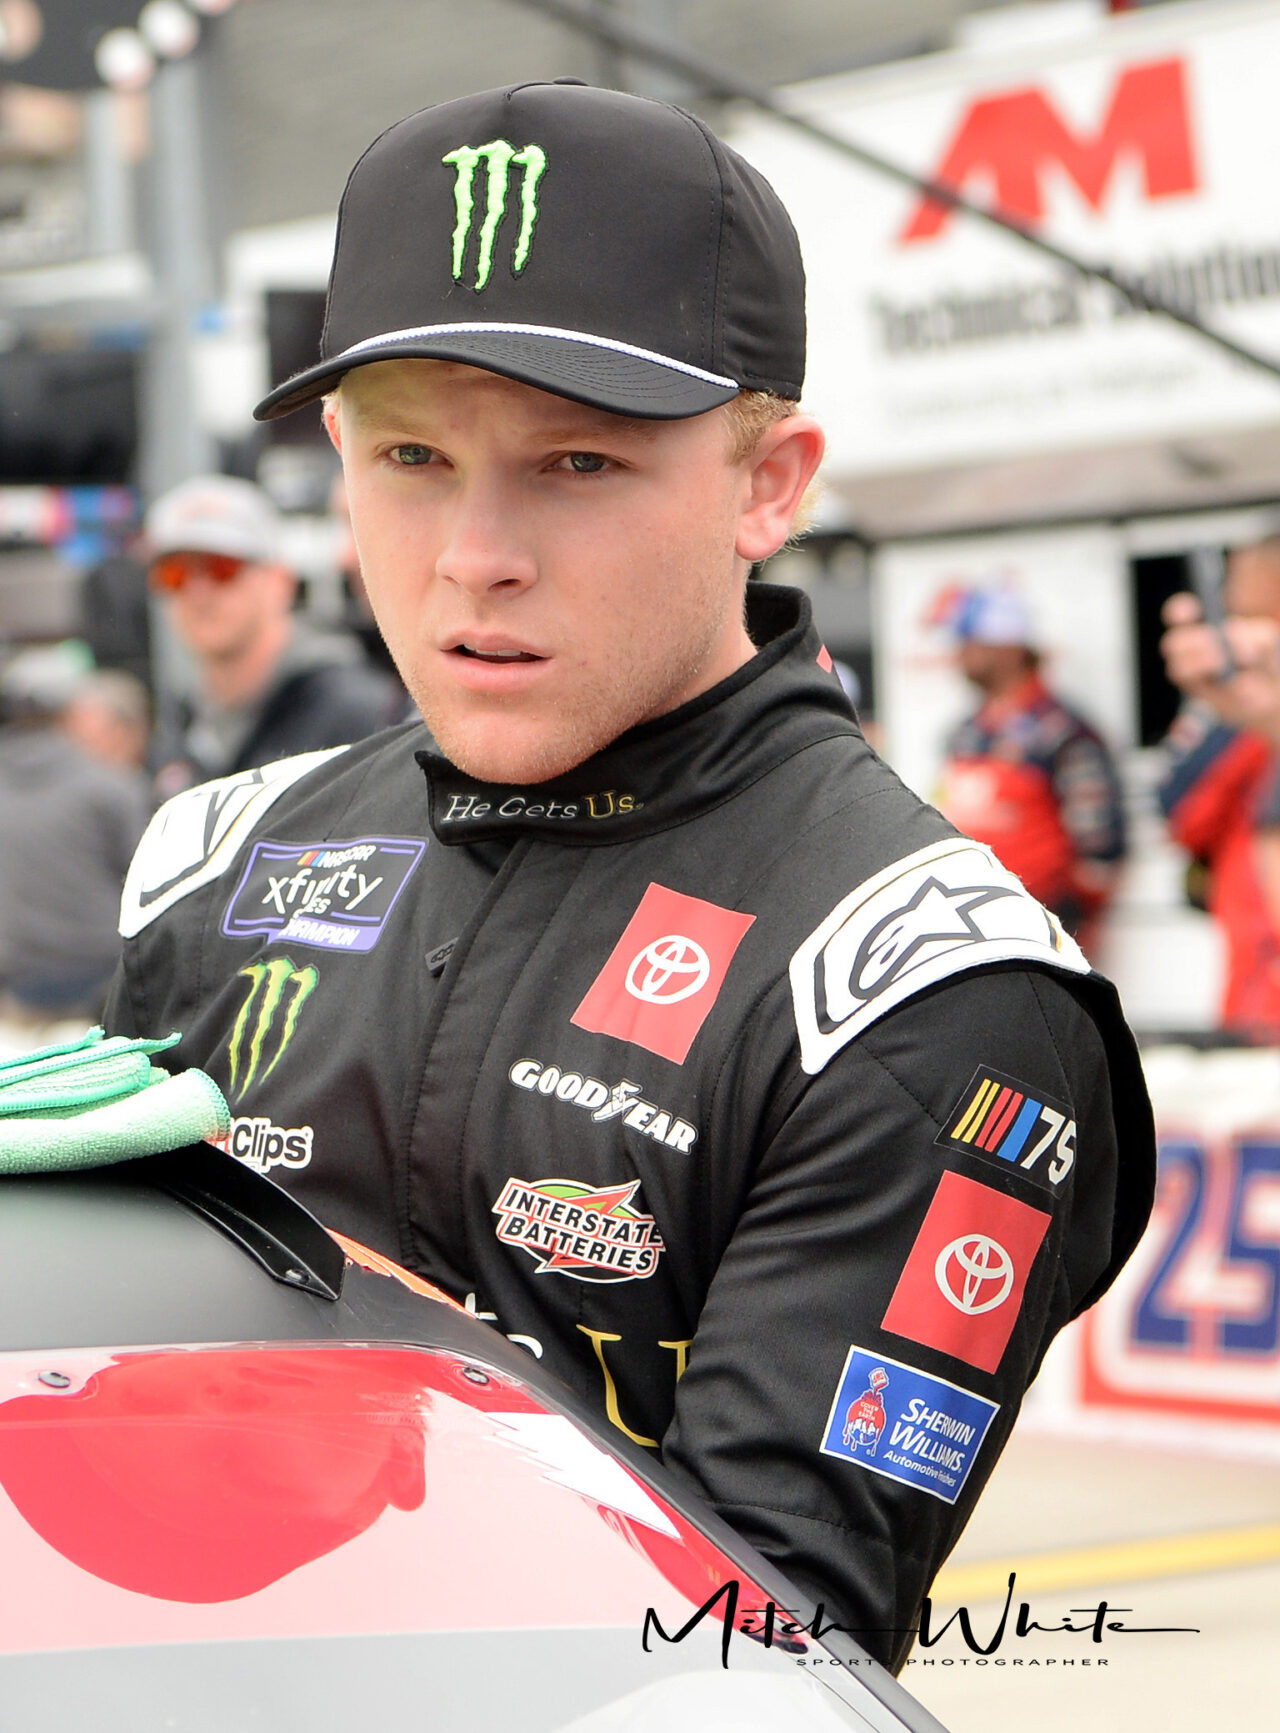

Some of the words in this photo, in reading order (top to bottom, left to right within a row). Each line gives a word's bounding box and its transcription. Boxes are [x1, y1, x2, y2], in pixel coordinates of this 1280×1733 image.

[440, 794, 491, 823] He
[498, 797, 578, 819] Gets
[510, 1060, 697, 1153] GOODYEAR
[1020, 1105, 1077, 1186] 75
[504, 1215, 653, 1271] BATTERIES
[505, 1188, 663, 1245] INTERSTATE
[900, 1398, 976, 1446] SHERWIN
[883, 1450, 939, 1478] Automotive
